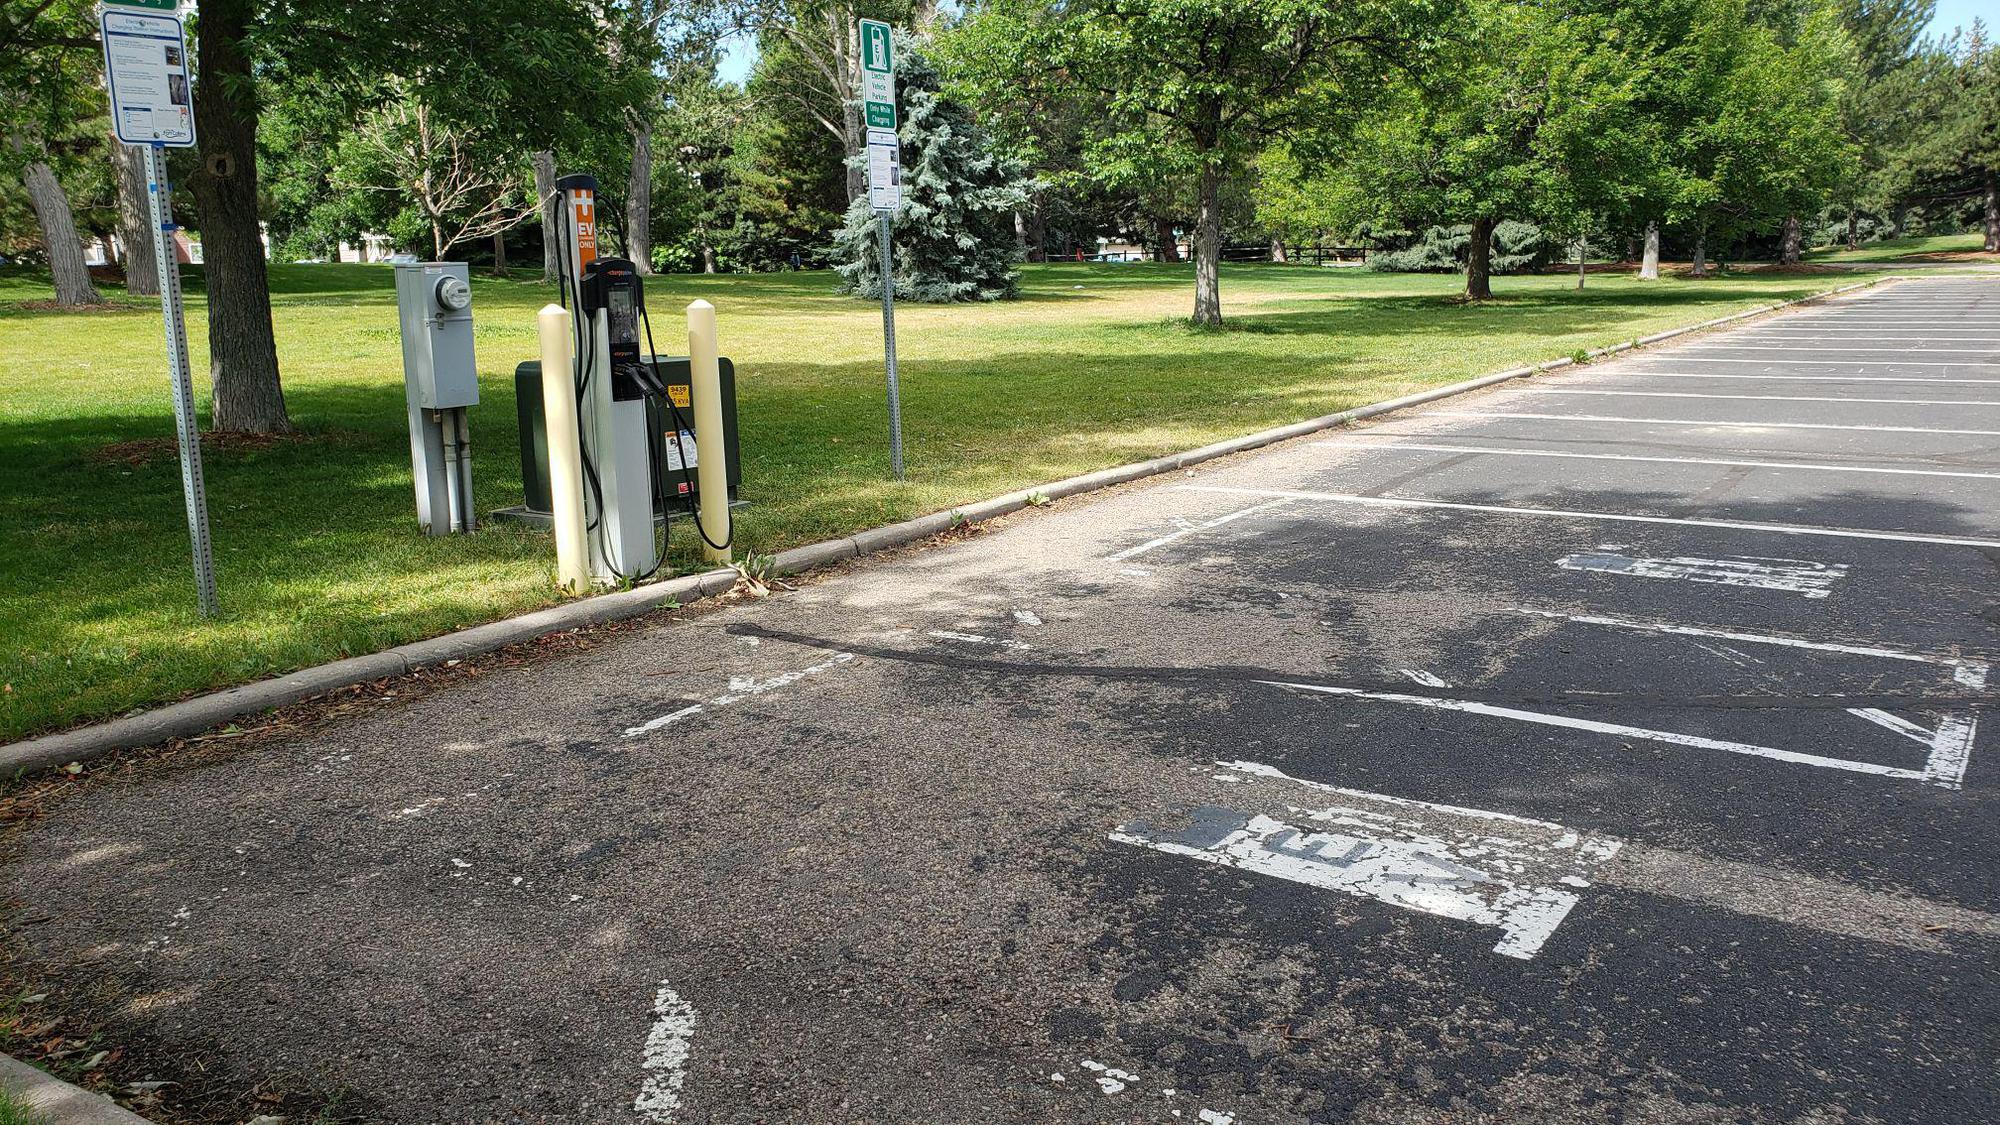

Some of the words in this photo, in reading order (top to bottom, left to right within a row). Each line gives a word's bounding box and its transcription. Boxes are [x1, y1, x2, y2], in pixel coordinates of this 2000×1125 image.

[874, 44, 880, 63] EV
[871, 71, 886, 81] Electric
[871, 82, 887, 91] Vehicle
[872, 92, 887, 103] Parking
[871, 114, 890, 127] Charging
[578, 222, 594, 236] EV
[579, 241, 594, 249] ONLY
[1263, 828, 1493, 887] EV
